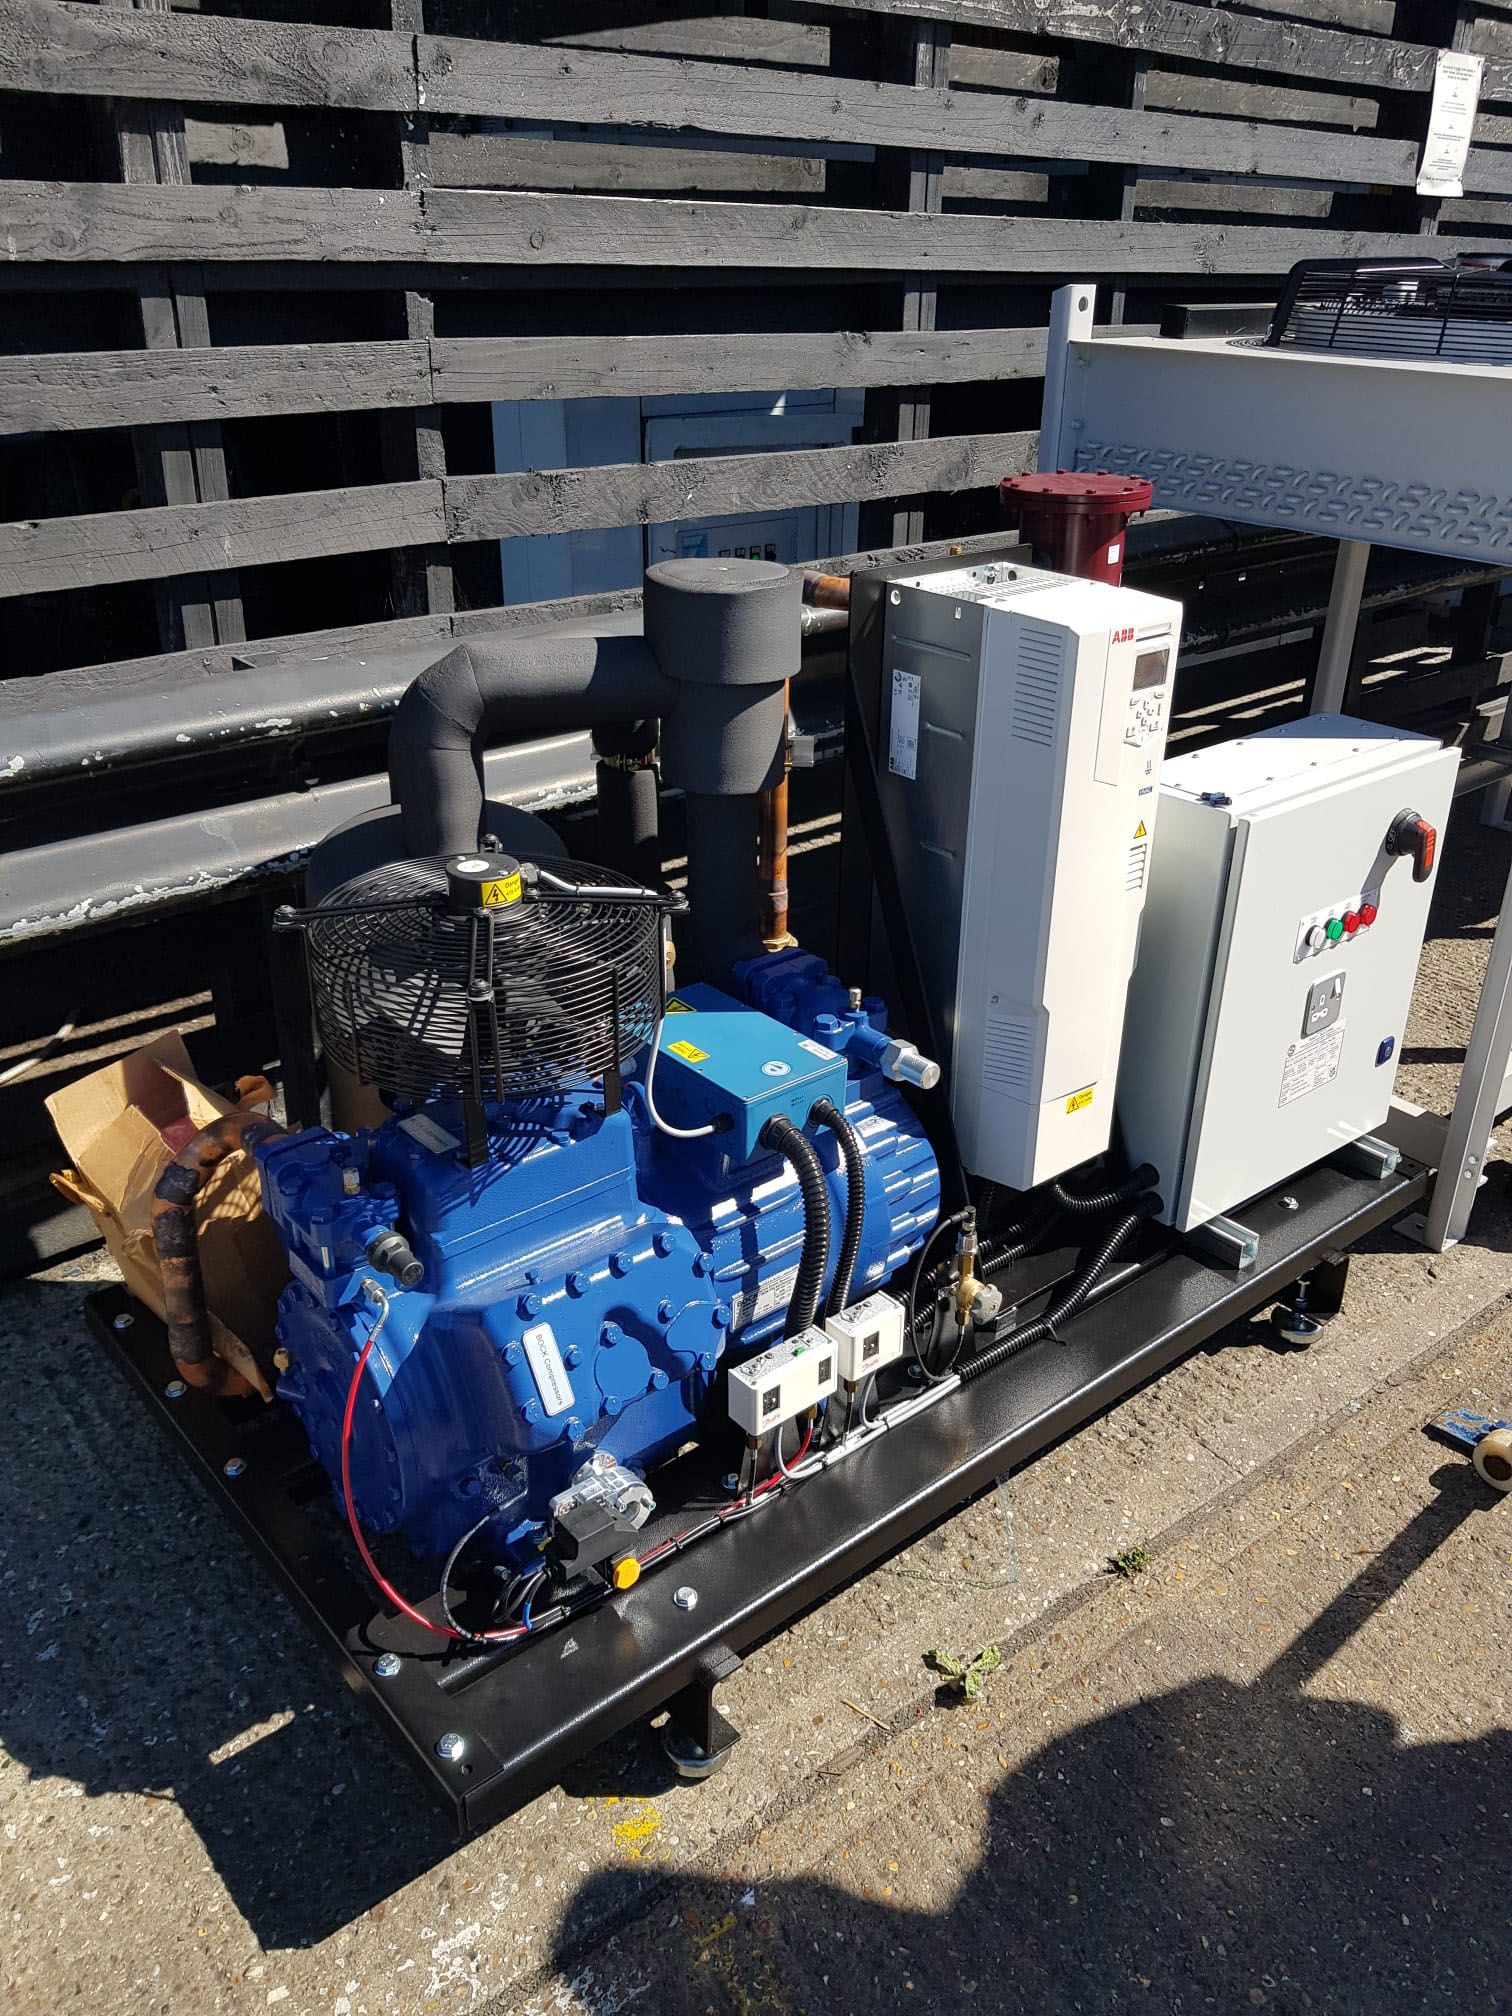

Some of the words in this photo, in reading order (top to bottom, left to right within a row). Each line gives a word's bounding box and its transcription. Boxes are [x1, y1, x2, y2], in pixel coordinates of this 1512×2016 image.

[1112, 627, 1134, 644] ABB
[535, 1334, 546, 1357] BOCK
[543, 1358, 563, 1406] Compressors
